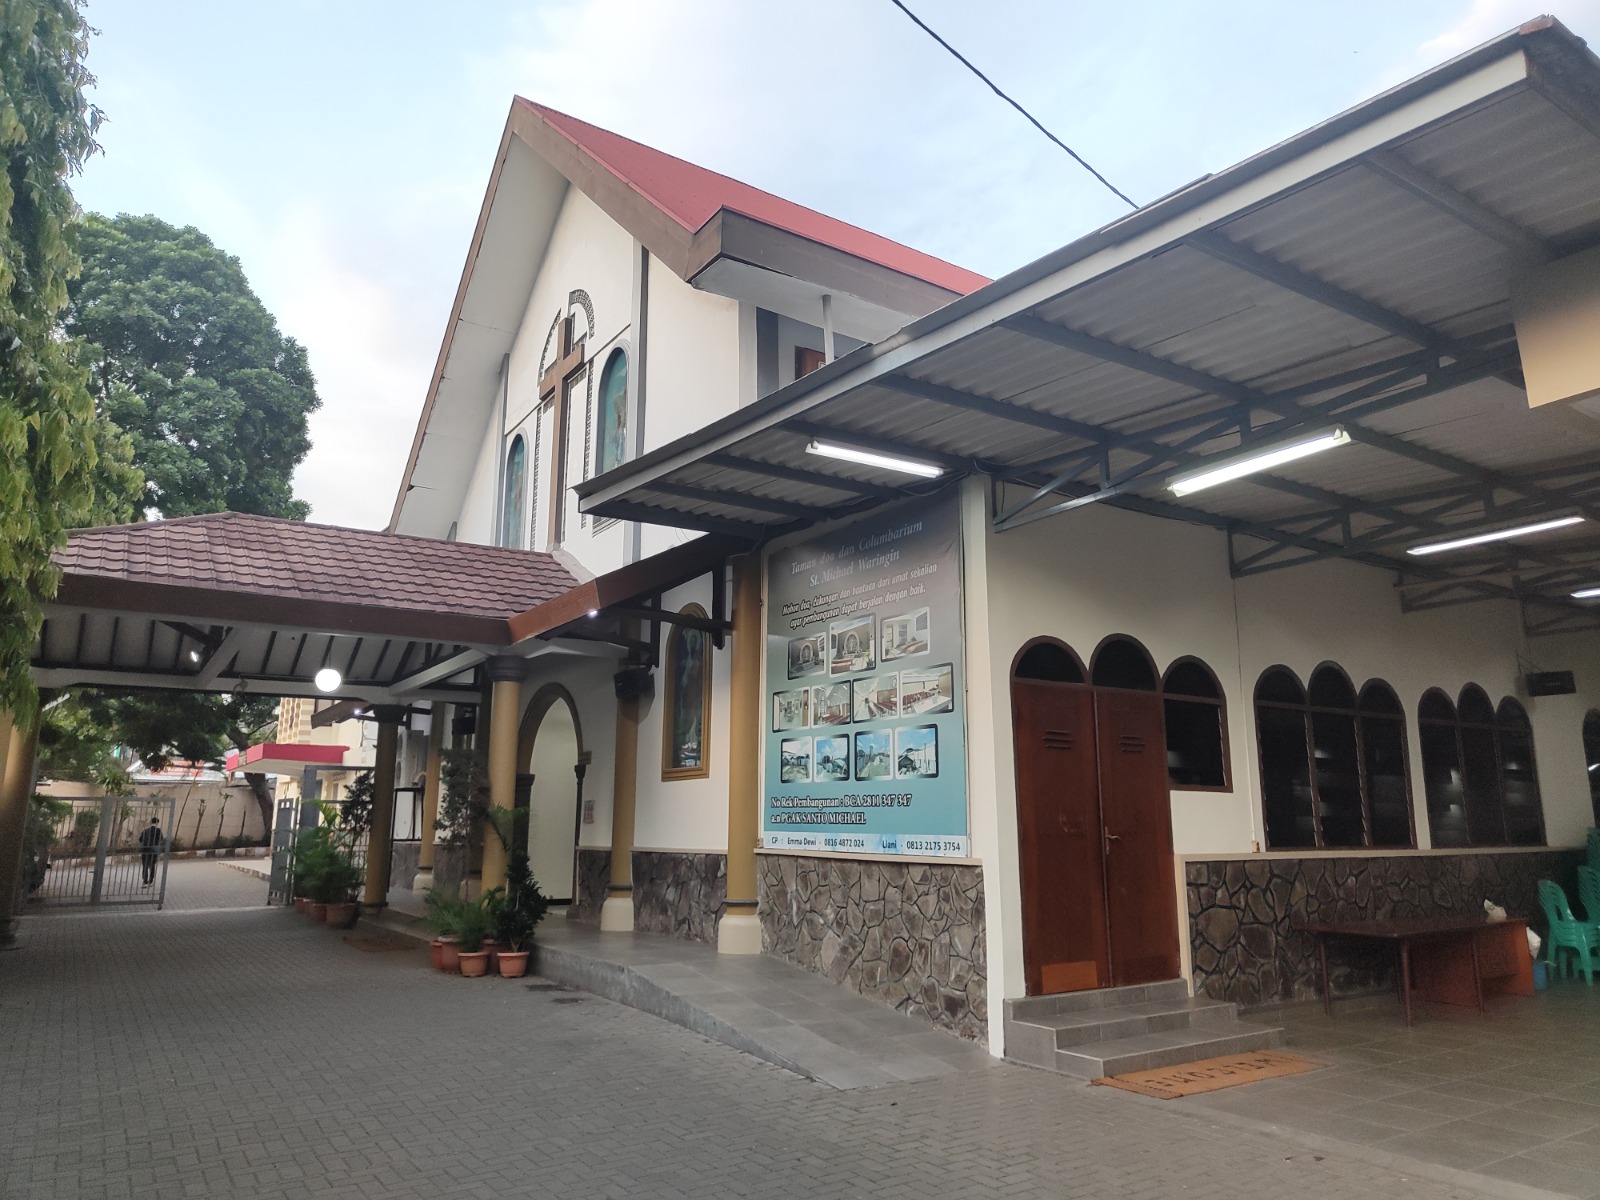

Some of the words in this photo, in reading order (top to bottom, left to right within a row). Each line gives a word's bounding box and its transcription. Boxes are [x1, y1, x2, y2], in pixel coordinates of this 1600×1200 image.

[791, 558, 817, 575] Taman
[819, 551, 835, 565] doa
[838, 544, 855, 559] dan
[859, 521, 923, 551] Columbarium
[809, 574, 820, 587] St.
[821, 562, 854, 583] Michael
[858, 549, 900, 570] Waringin
[782, 602, 799, 616] Mohon
[813, 592, 838, 606] dukungan
[839, 588, 851, 600] dan
[852, 582, 876, 596] bantuan
[877, 575, 891, 588] dari
[891, 571, 908, 585] umat
[910, 563, 938, 579] sekalian
[790, 617, 803, 630] agar
[802, 607, 840, 627] pembangunan
[841, 601, 858, 616] dapat
[859, 595, 883, 610] berjalan
[884, 589, 908, 603] dengan
[909, 582, 926, 596] baik.
[771, 797, 781, 808] No
[781, 796, 793, 807] Rek
[794, 795, 839, 810] Pembangunan
[862, 794, 880, 807] 2811
[881, 794, 896, 807] 347
[897, 793, 913, 807] 347
[781, 812, 801, 824] PGAK
[802, 812, 828, 824] SANTO
[828, 811, 866, 825] MICHAEL
[771, 836, 779, 844] CP
[787, 837, 803, 845] Emma
[803, 837, 817, 846] Dewi
[824, 838, 838, 847] 0816
[854, 838, 865, 848] 024
[882, 840, 897, 849] Liani
[906, 840, 923, 850] 0813
[924, 841, 941, 851] 2175
[943, 841, 961, 851] 3754
[1145, 1057, 1280, 1087] WELCOME
